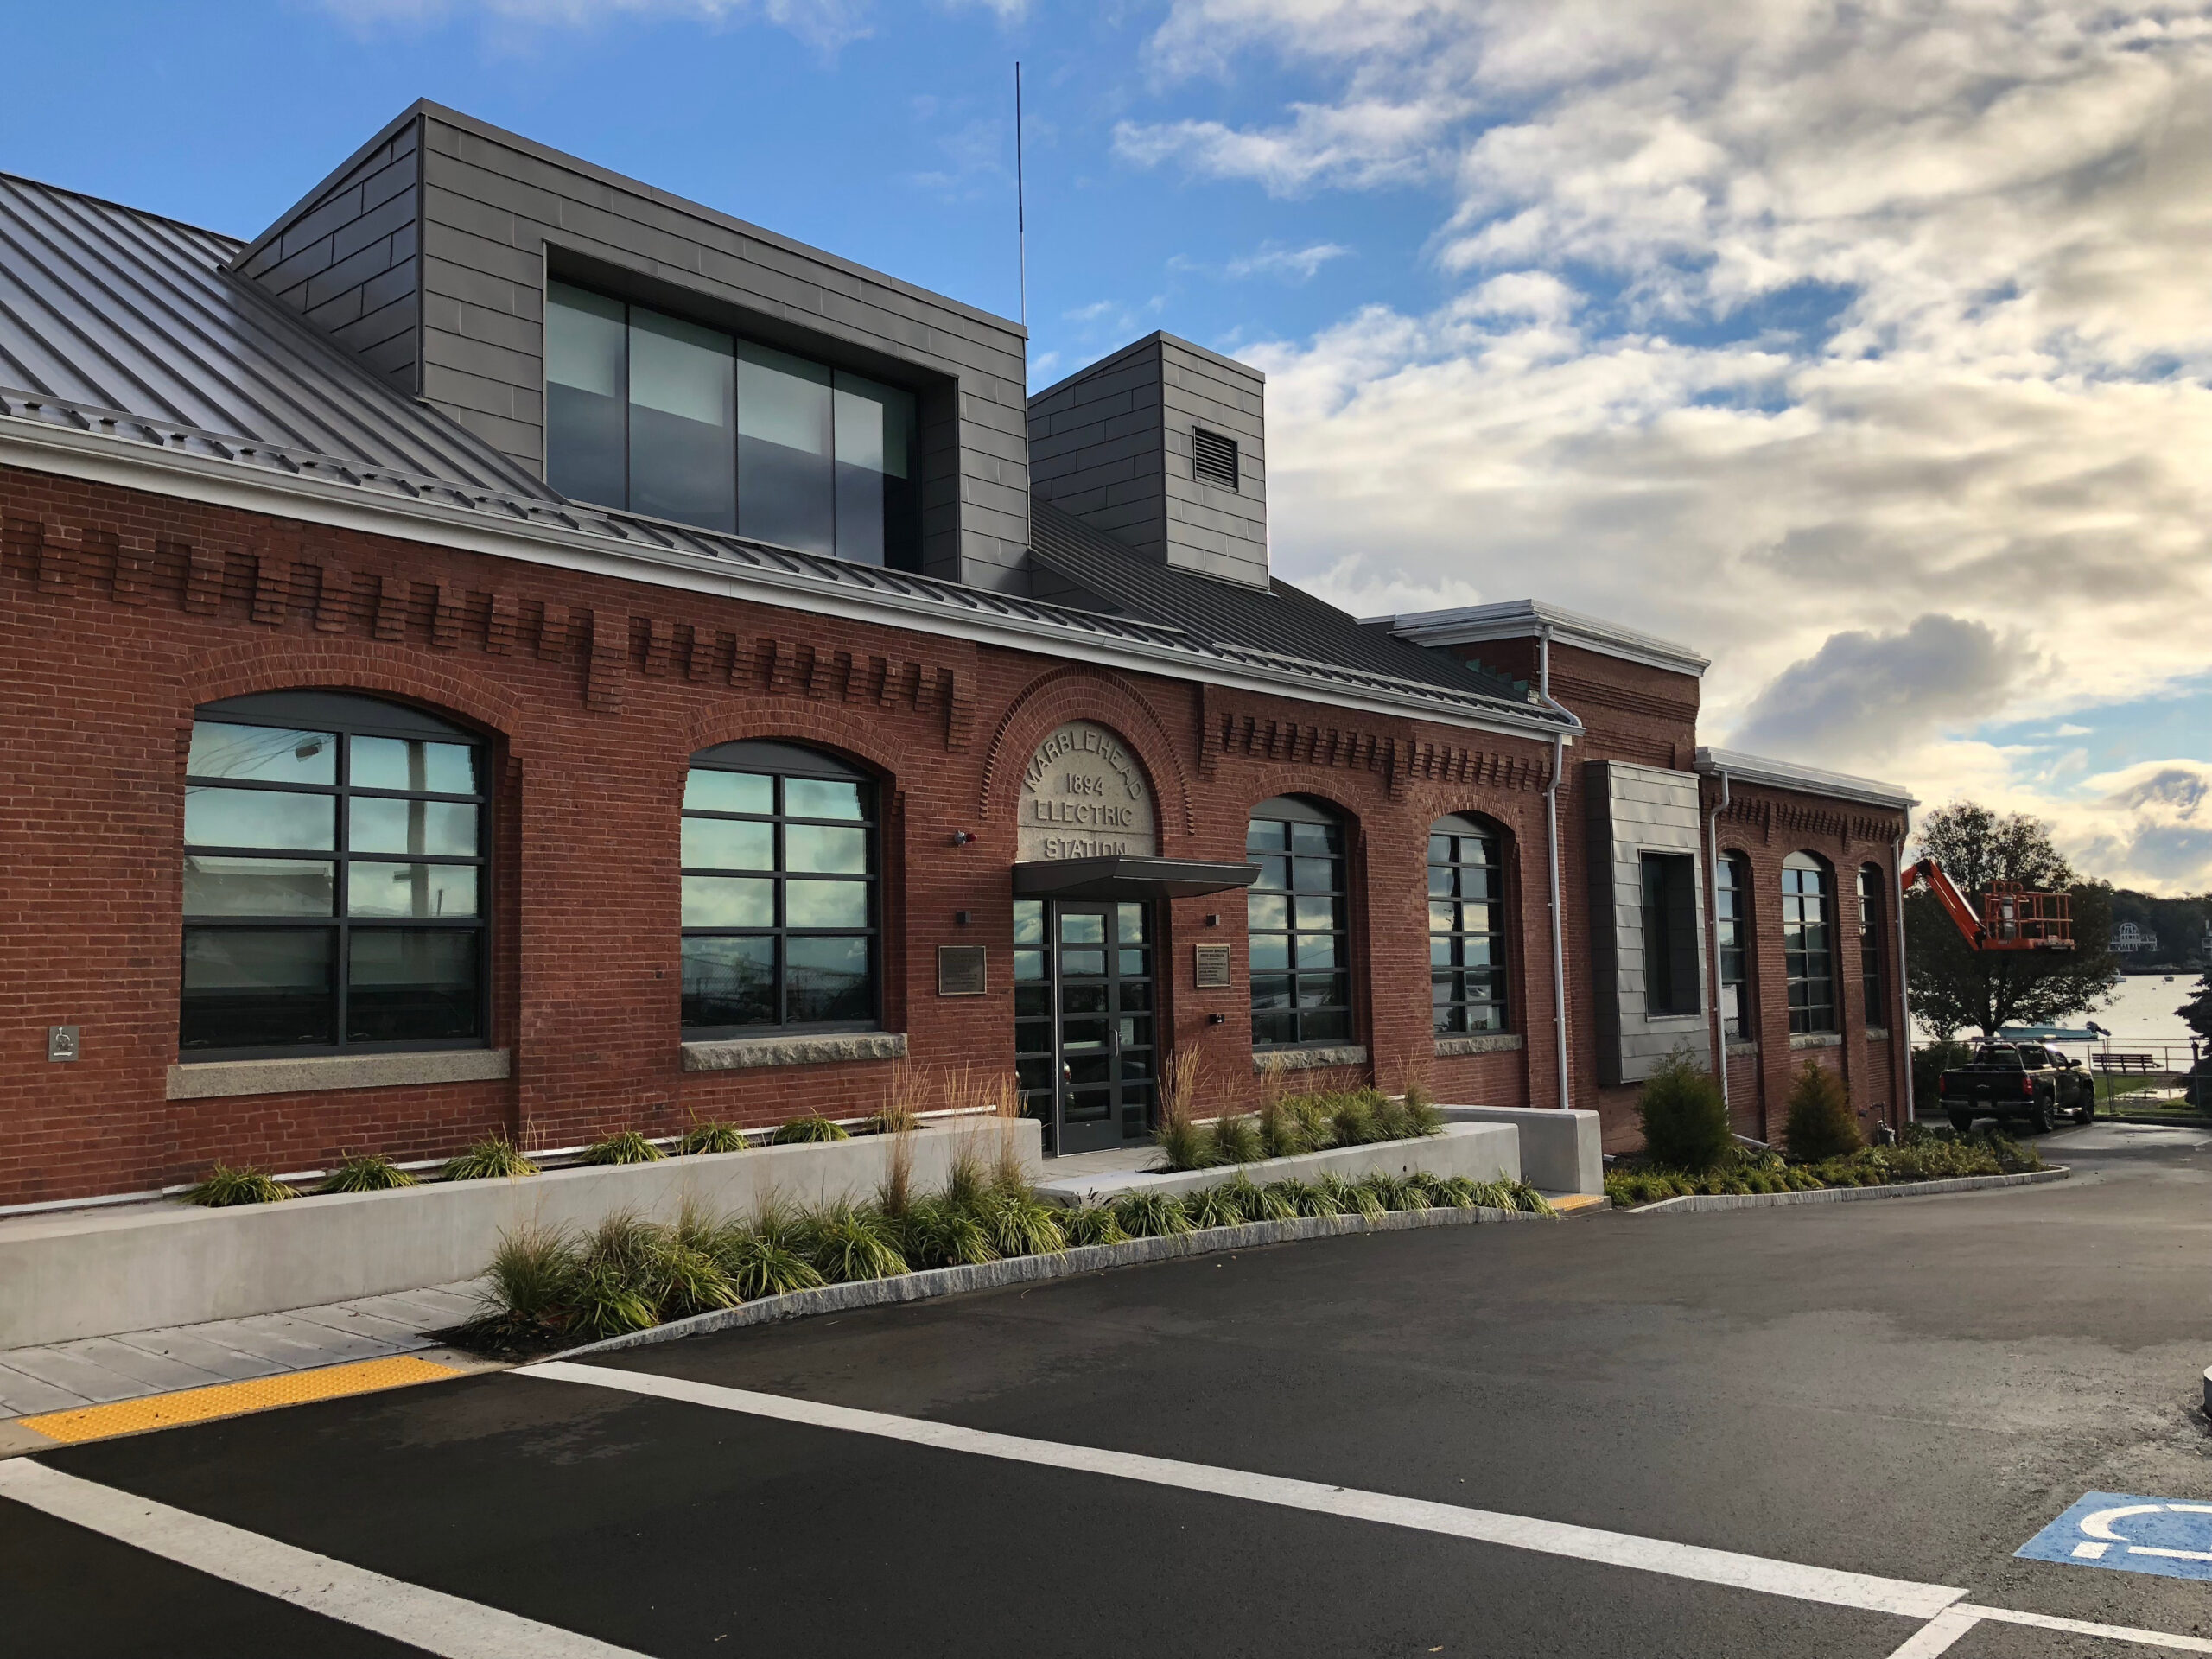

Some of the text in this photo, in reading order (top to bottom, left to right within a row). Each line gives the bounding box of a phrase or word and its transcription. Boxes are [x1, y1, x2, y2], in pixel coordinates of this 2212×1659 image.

[1024, 730, 1142, 800] MARBLEHEAD
[1066, 773, 1104, 796] 1894
[1035, 799, 1133, 827] ELECTRIC
[1045, 836, 1126, 858] STATION
